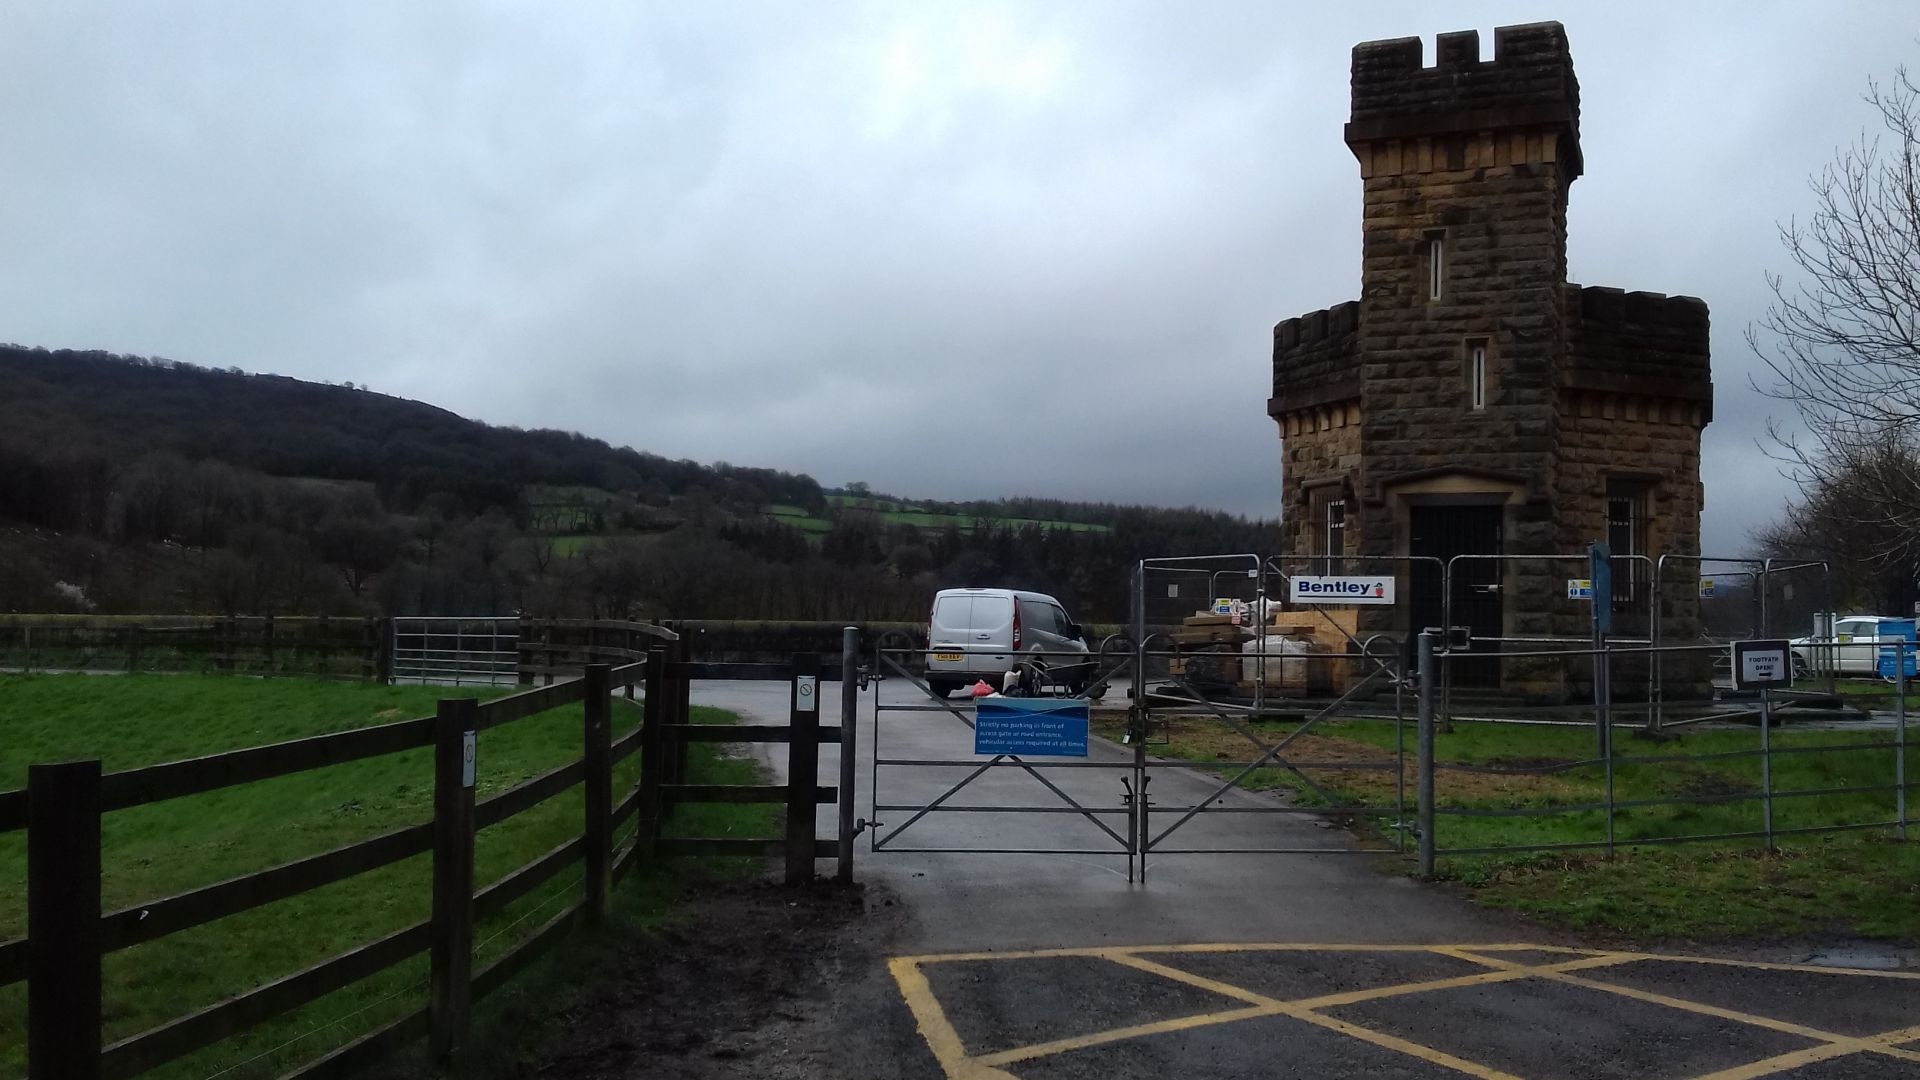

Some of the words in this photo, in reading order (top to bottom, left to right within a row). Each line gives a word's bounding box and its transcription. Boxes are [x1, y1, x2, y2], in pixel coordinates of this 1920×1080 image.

[1298, 581, 1370, 595] Bentley
[979, 721, 999, 730] Strictly
[1010, 722, 1033, 730] parking
[998, 730, 1011, 738] gate
